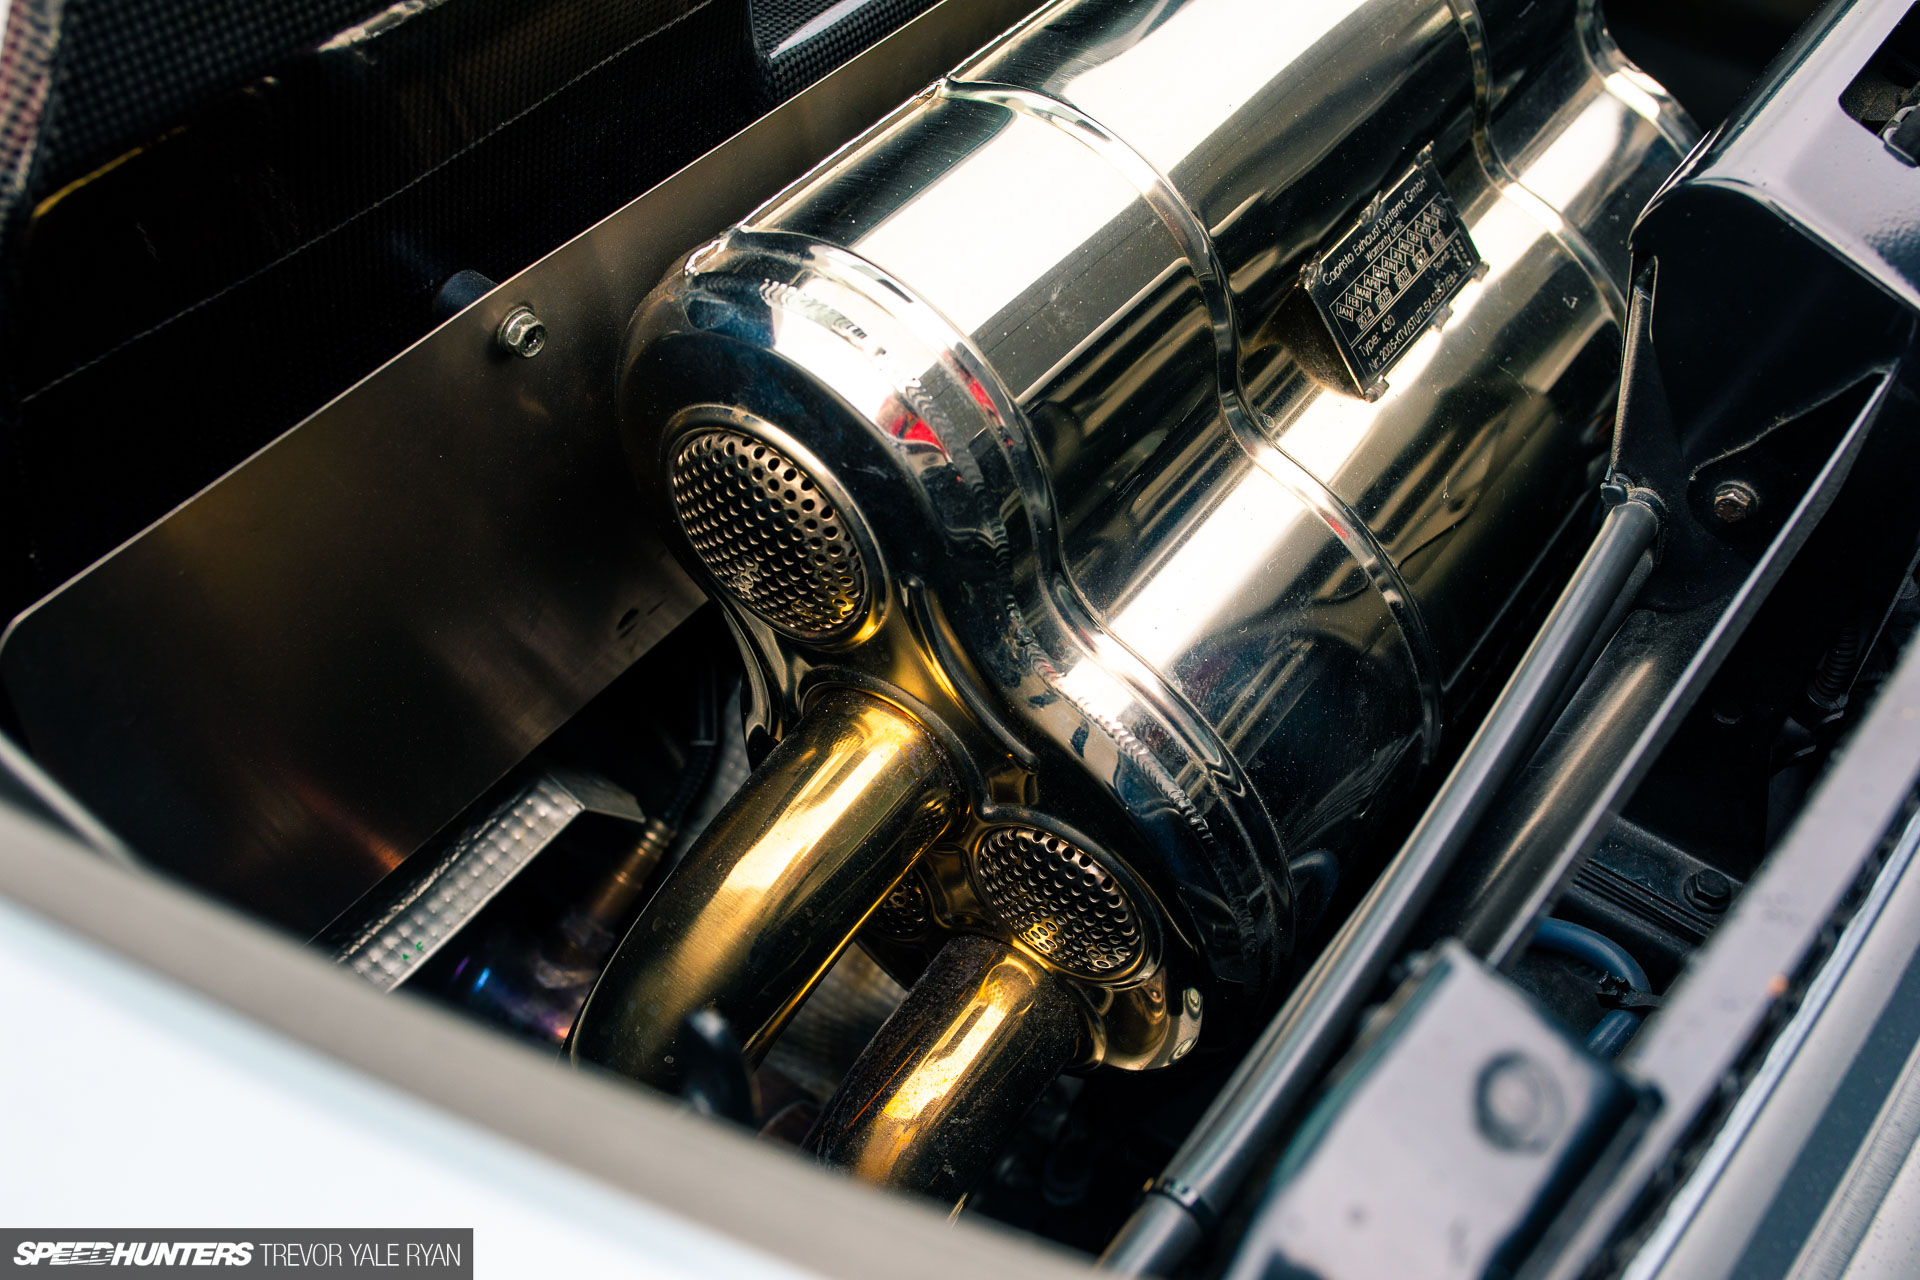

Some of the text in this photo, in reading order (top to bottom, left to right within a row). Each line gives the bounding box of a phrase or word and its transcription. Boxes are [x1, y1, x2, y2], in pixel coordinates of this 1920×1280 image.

[1322, 177, 1428, 287] Capristo Exhaust Systems GmbH
[1364, 233, 1391, 262] Warranty
[1339, 305, 1352, 318] JAN
[1348, 296, 1360, 308] FEB
[1356, 286, 1369, 300] MAR
[1366, 277, 1379, 290] APR
[1383, 259, 1396, 271] JUN
[1392, 251, 1404, 262] JUL
[1400, 241, 1414, 253] AUG
[1409, 232, 1420, 243] SEP
[1358, 308, 1373, 329] 2014
[1377, 287, 1392, 309] 2015
[1358, 315, 1396, 356] Type: 430
[1368, 356, 1382, 372] Nr:
